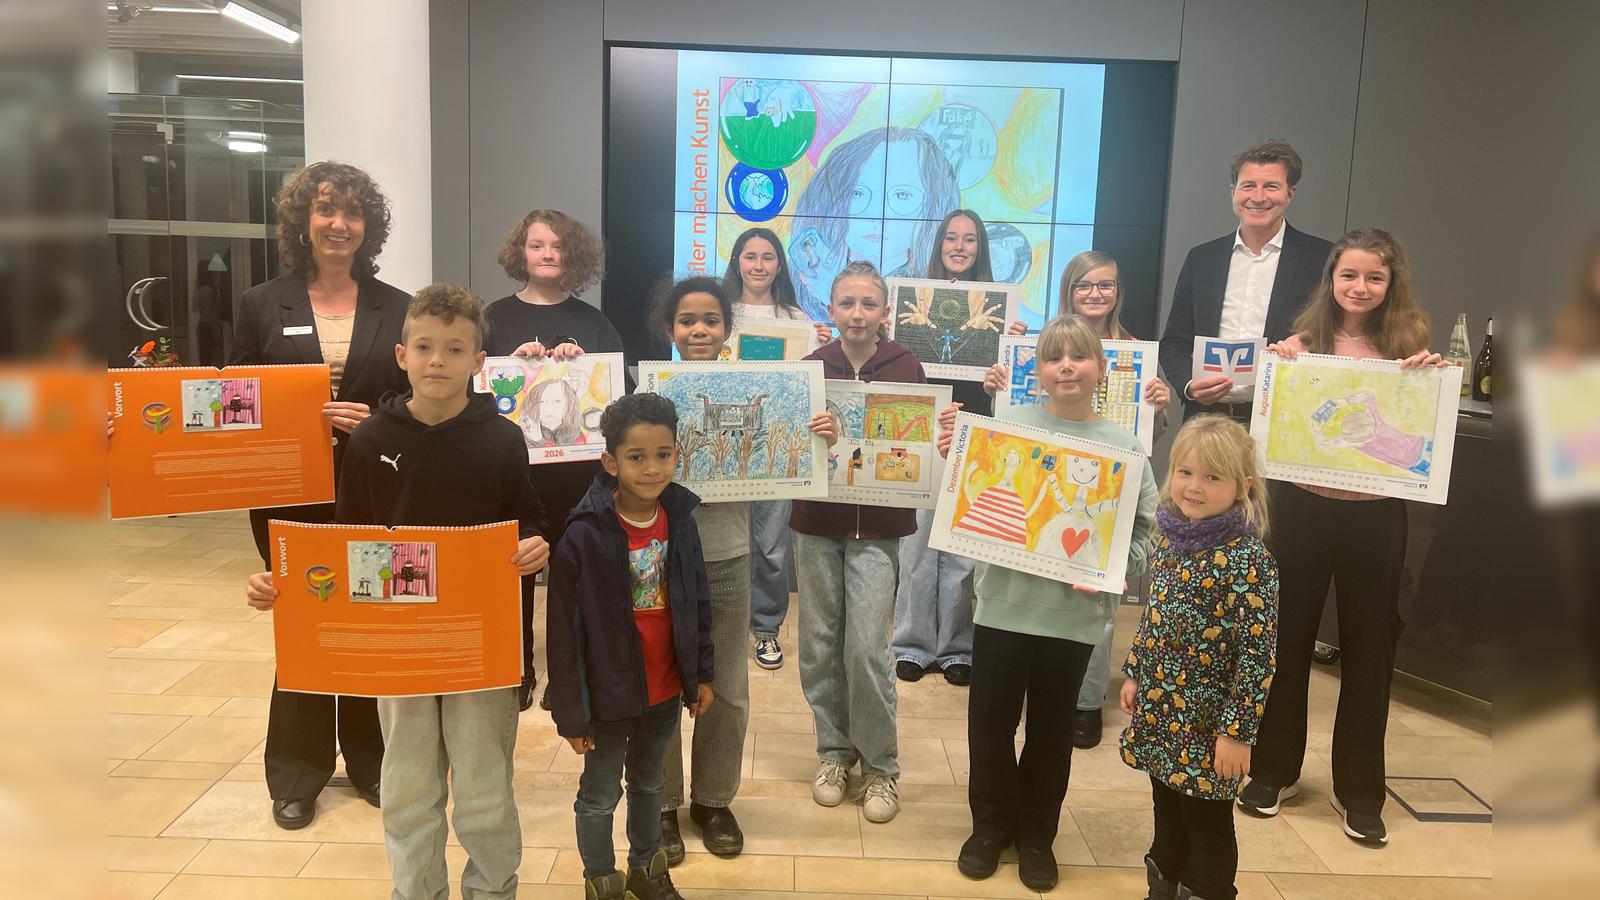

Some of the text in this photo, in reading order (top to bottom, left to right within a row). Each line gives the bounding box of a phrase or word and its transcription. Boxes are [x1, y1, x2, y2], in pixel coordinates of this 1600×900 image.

[690, 88, 710, 148] Kunst
[689, 154, 708, 234] machen
[113, 382, 123, 418] Vorwort
[544, 450, 565, 458] 2026
[278, 536, 288, 577] Vorwort
